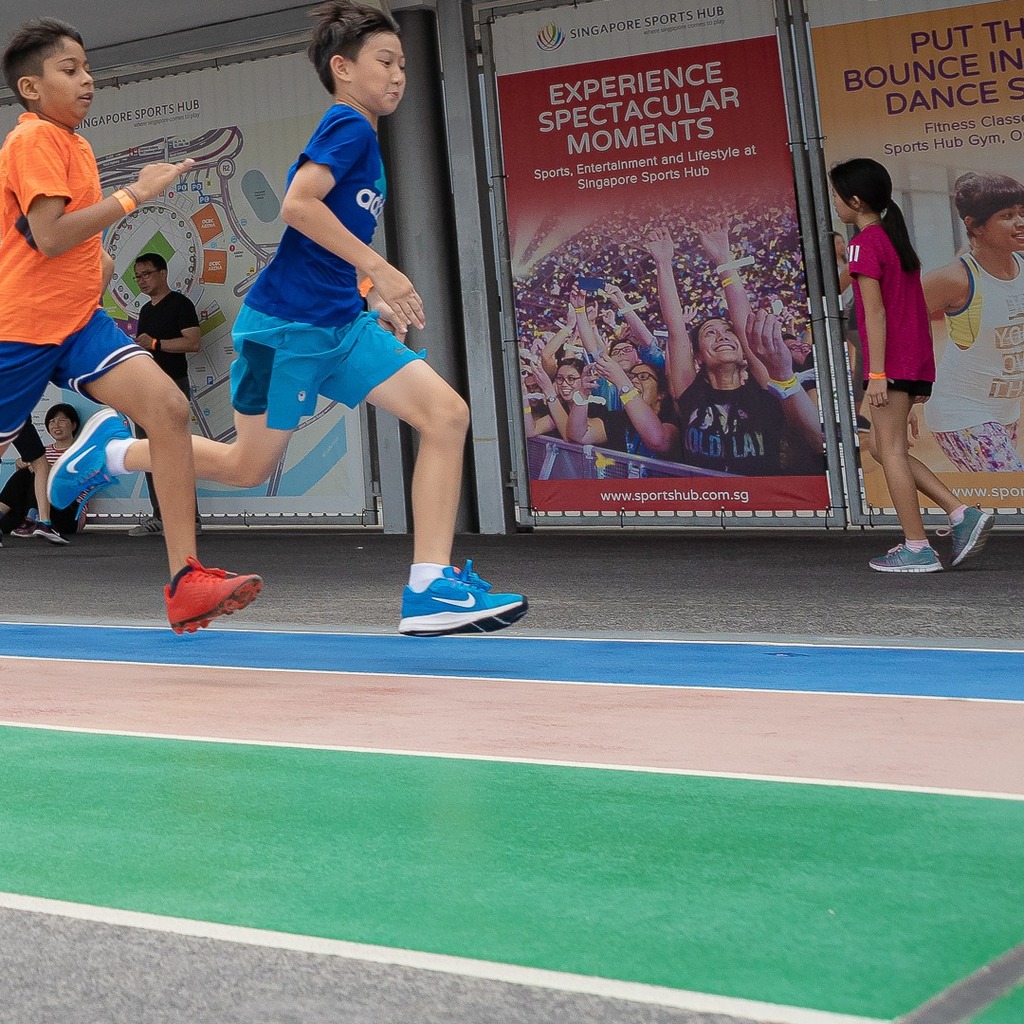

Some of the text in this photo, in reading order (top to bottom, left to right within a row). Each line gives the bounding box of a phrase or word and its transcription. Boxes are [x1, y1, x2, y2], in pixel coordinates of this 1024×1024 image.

[570, 6, 724, 39] SINGAPORE SPORTS HUB
[911, 17, 1024, 54] PUT TH
[549, 61, 724, 106] EXPERIENCE
[844, 48, 1023, 92] BOUNCE IN
[75, 99, 200, 130] SINGAPORE SPORTS HUB
[538, 87, 740, 133] SPECTACULAR
[885, 81, 999, 115] DANCE
[567, 117, 714, 155] MOMENTS
[884, 129, 1024, 156] Sports Hub Gym, O
[924, 120, 976, 134] Fitness
[533, 144, 757, 181] Sports, Entertainment and Lifestyle at
[577, 165, 710, 191] Singapore Sports Hub
[600, 488, 750, 504] www.sportshub.com.sg
